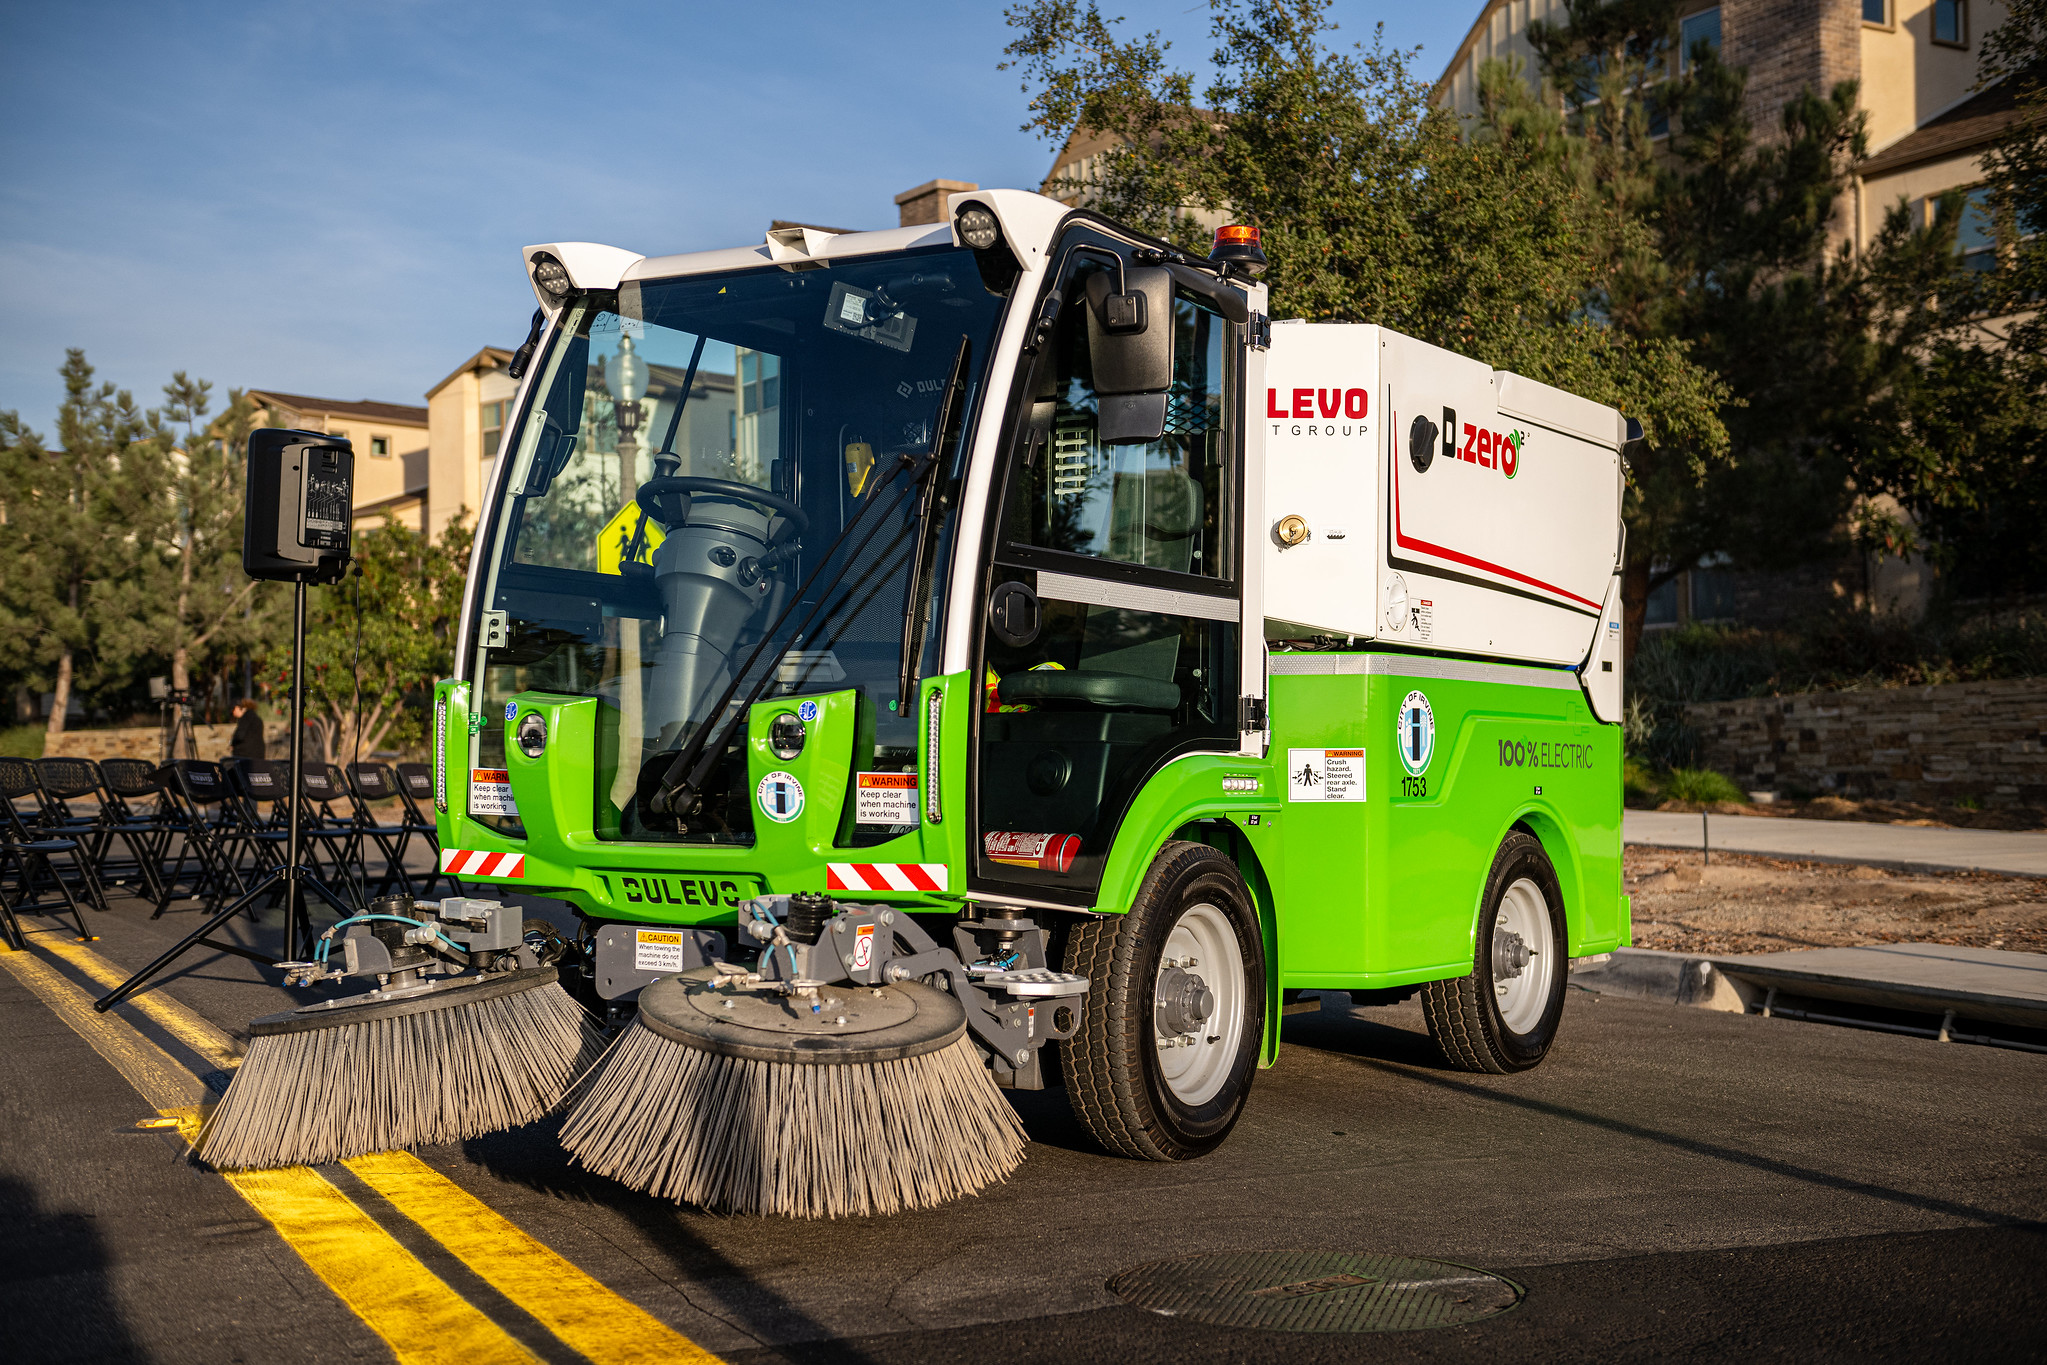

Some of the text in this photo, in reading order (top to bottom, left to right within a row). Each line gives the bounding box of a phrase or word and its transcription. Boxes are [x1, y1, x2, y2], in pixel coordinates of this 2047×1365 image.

[1267, 388, 1368, 419] LEVO
[1291, 425, 1368, 436] GROUP
[1398, 693, 1434, 730] CITY OF IRVINE
[1498, 739, 1593, 769] 100% ELECTRIC
[758, 776, 769, 794] CITY
[784, 774, 803, 797] IRVINE
[871, 776, 917, 786] WARNING
[474, 784, 491, 793] Keep
[1401, 777, 1427, 797] 1753
[860, 790, 880, 799] Keep
[481, 803, 507, 811] working
[860, 800, 916, 809] when machine
[860, 809, 900, 819] is working
[622, 877, 740, 908] DULEVO
[648, 934, 679, 943] CAUTION
[654, 945, 671, 953] towing
